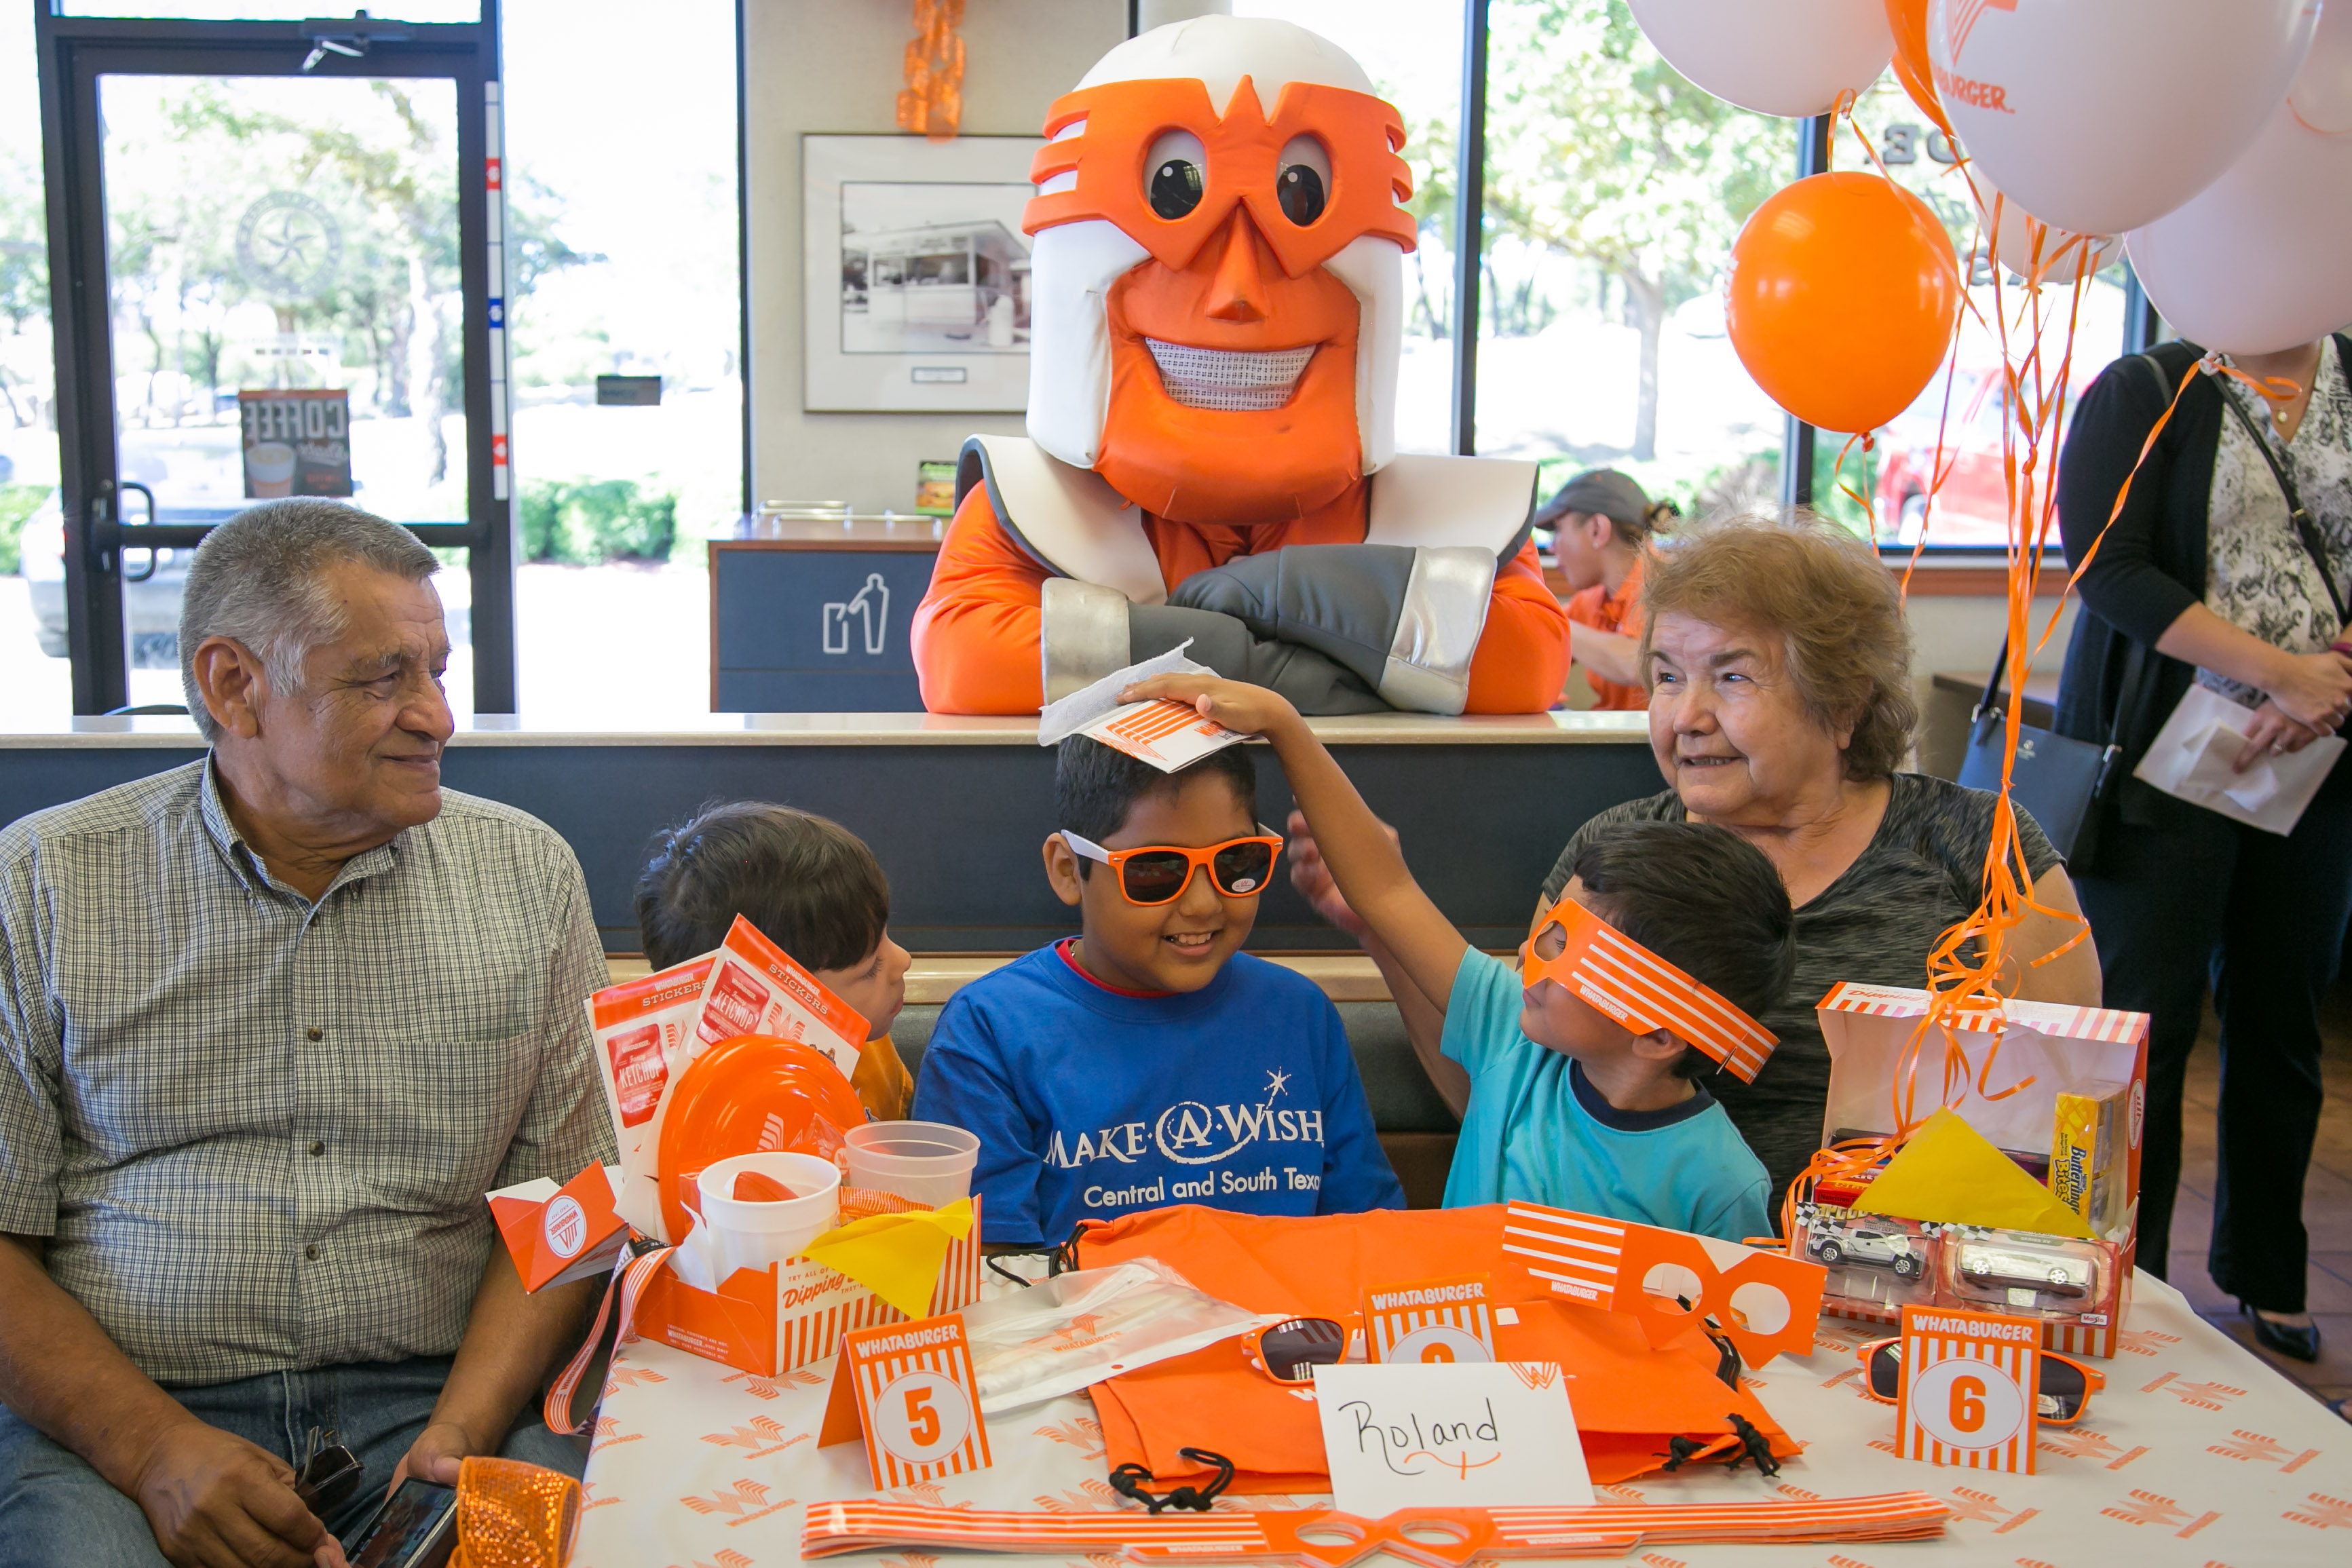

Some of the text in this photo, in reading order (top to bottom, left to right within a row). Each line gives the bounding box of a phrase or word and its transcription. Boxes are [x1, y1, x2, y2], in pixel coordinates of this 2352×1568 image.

[643, 980, 707, 1007] STICKERS
[769, 963, 829, 1015] STICKERS
[1579, 984, 1629, 1022] WHATABURGER
[715, 990, 755, 1031] KETCHUP
[618, 1056, 664, 1089] KETCHUP
[1084, 1166, 1321, 1208] Central and South Texa
[2055, 1159, 2071, 1206] Bites
[782, 1273, 846, 1309] Dipping
[1370, 1282, 1486, 1311] WHATABURGER
[1551, 1280, 1599, 1302] WHATABURGER
[855, 1324, 960, 1359] WHATABURGER
[1912, 1314, 2034, 1342] WHATABURGER
[904, 1385, 941, 1447] 5
[1949, 1375, 1987, 1433] 6
[1338, 1397, 1498, 1476] Roland
